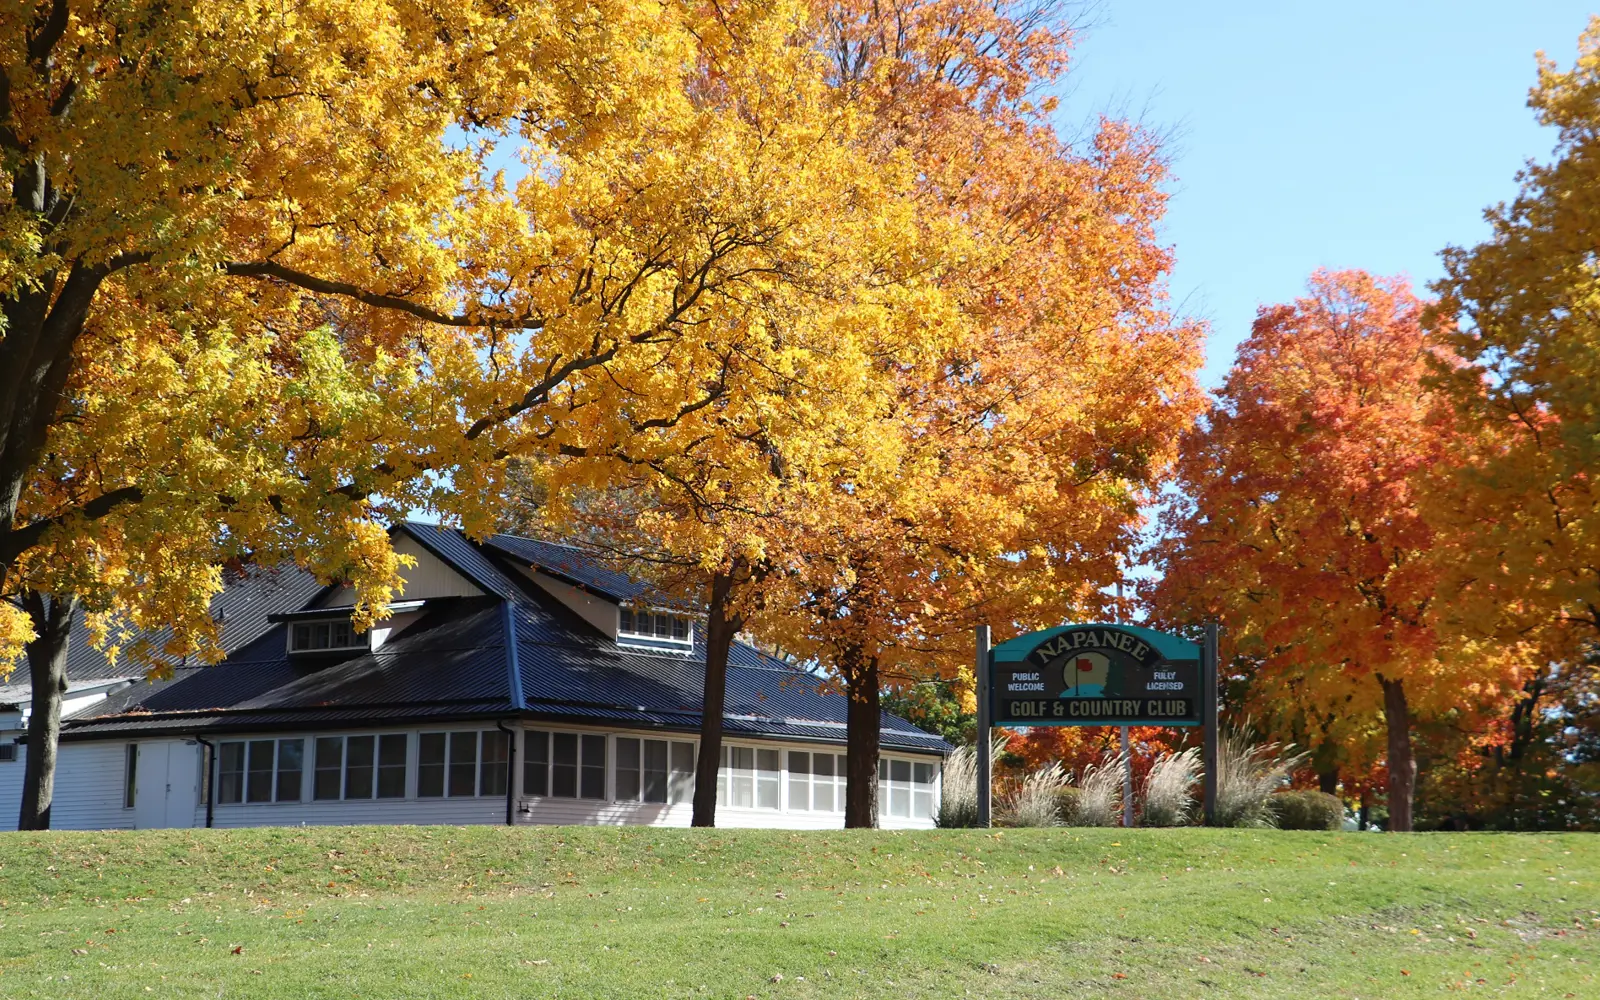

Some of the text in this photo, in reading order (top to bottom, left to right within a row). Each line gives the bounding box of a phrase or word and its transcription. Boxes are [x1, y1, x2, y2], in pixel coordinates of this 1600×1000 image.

[1036, 631, 1150, 663] NAPANEE
[1012, 672, 1040, 681] PUBLIC
[1153, 671, 1176, 680] FULLY
[1008, 682, 1045, 691] WELCOME
[1146, 682, 1184, 690] LICENSED
[1010, 700, 1186, 716] GOLF & COUNTRY CLUB
